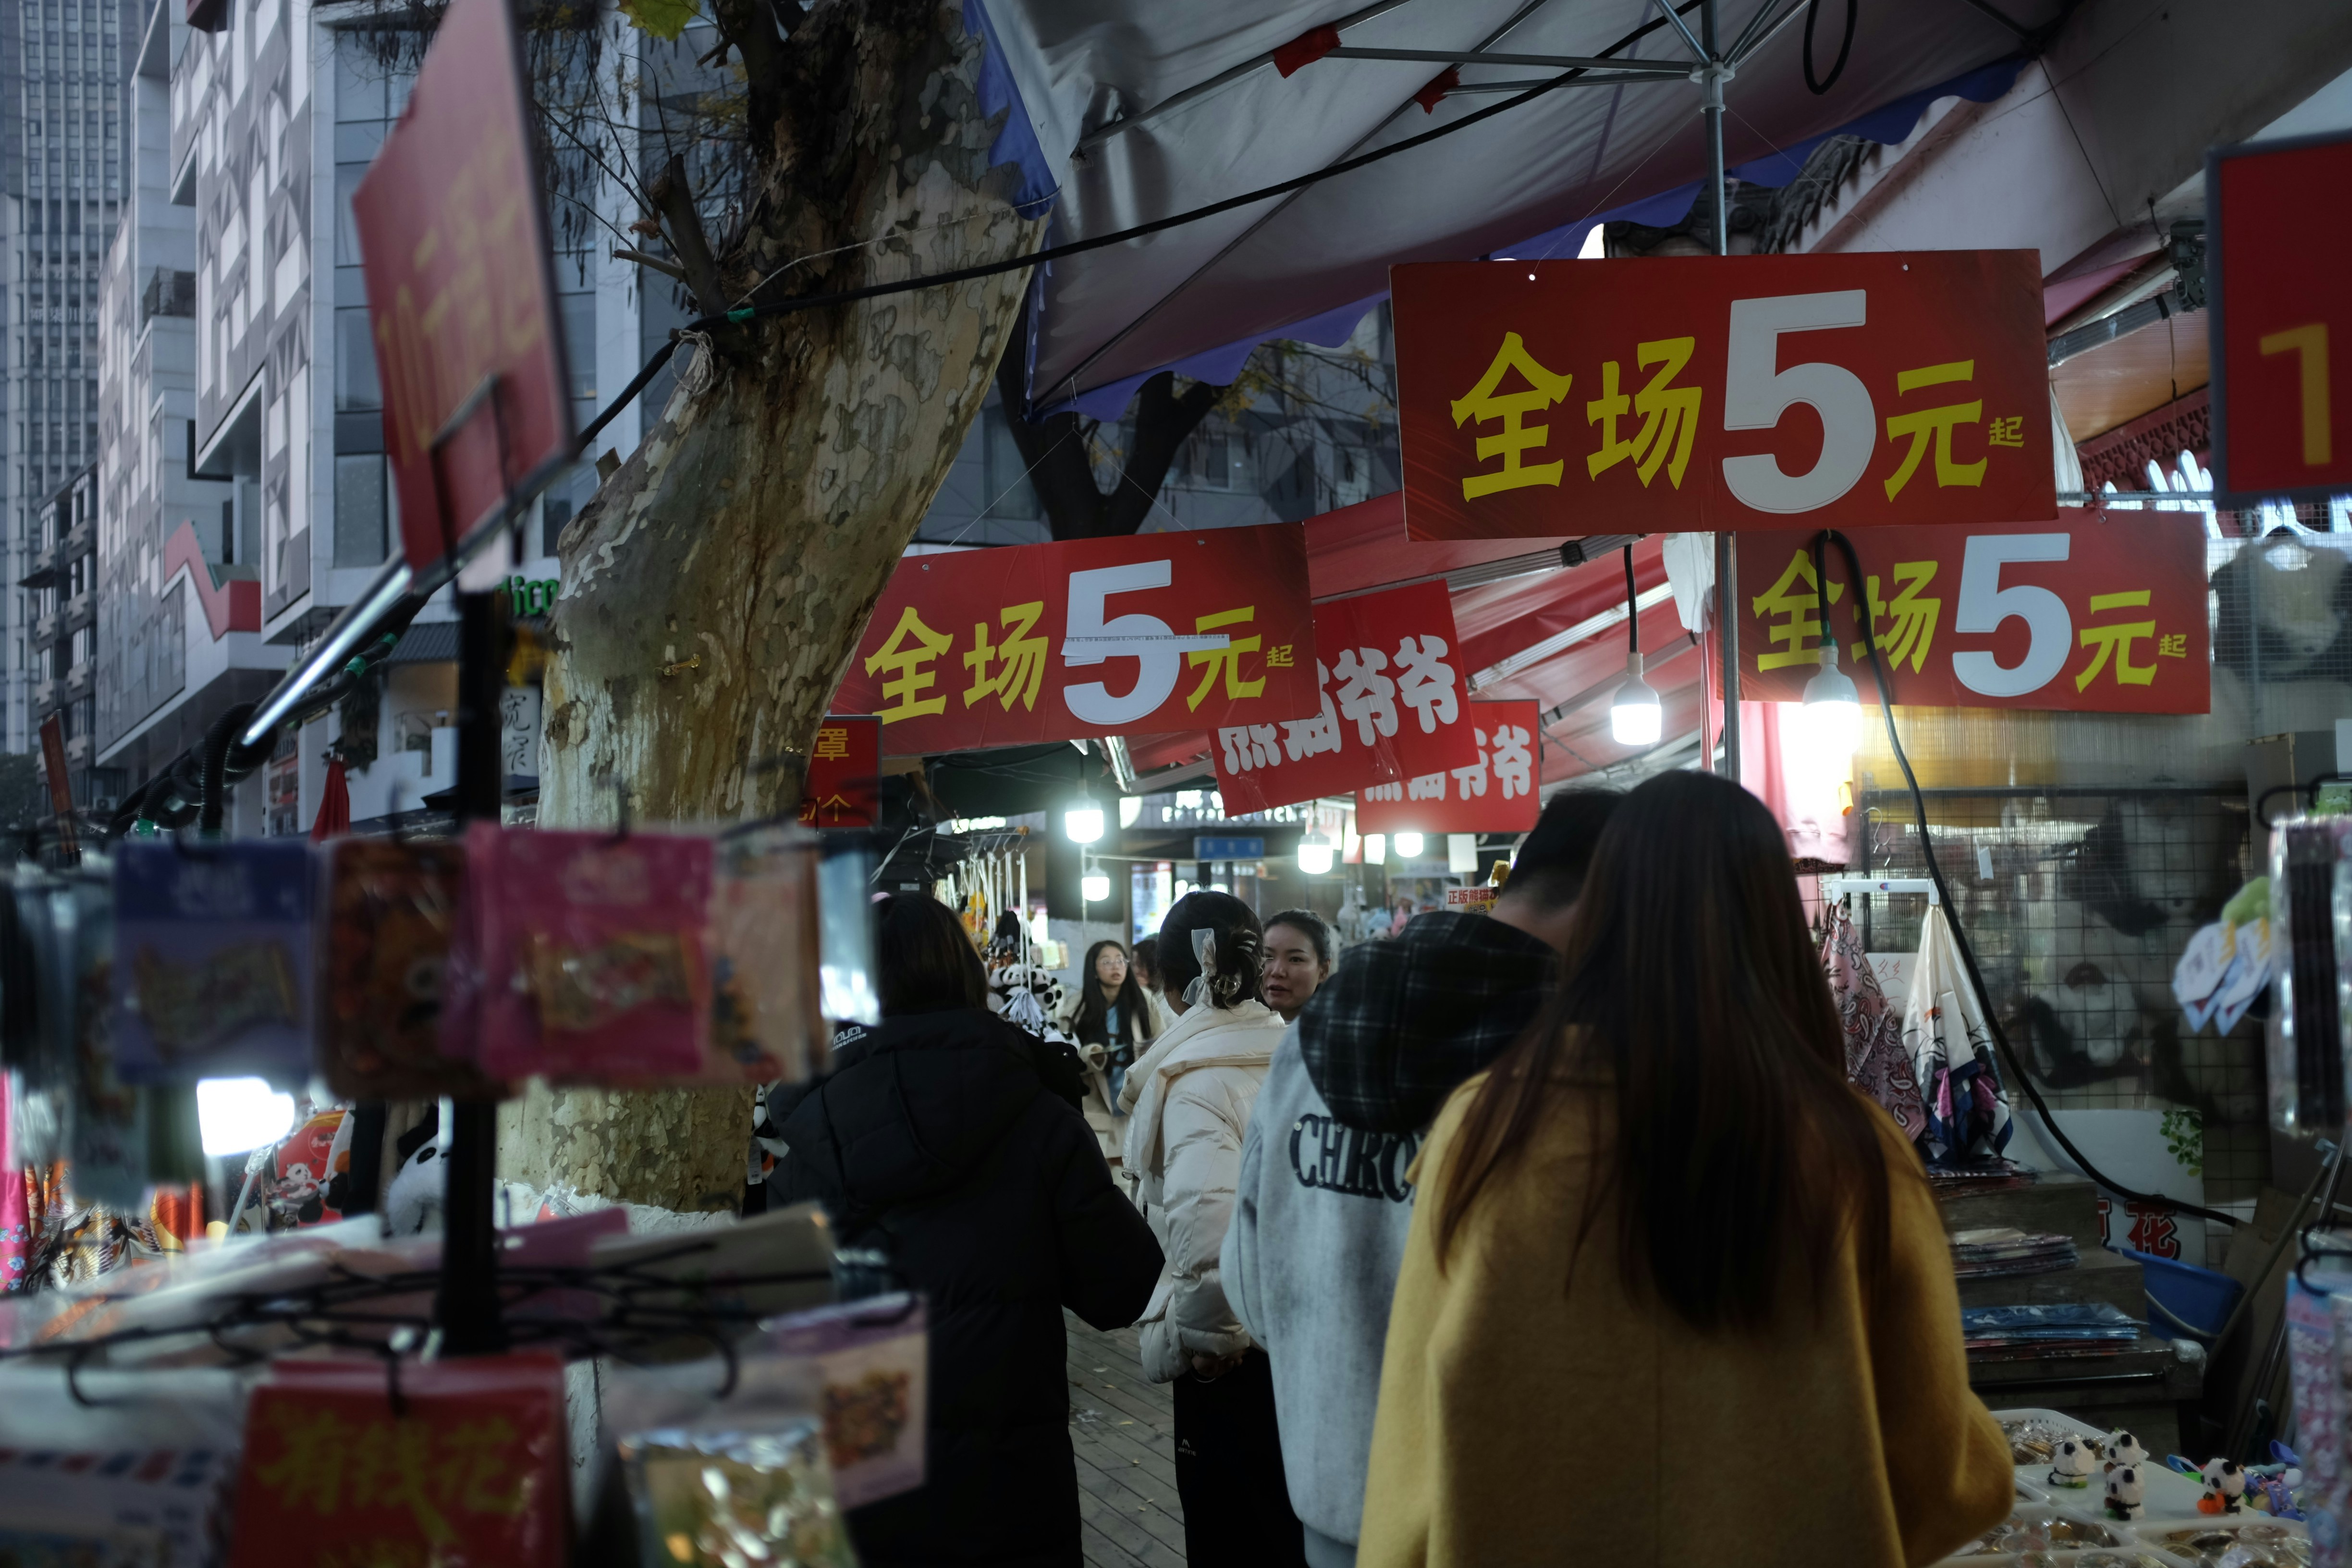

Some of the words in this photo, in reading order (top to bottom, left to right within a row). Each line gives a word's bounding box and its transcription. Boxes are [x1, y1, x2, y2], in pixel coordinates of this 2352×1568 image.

[1451, 289, 2024, 514] 全场5元起
[2260, 321, 2332, 466] 1
[864, 559, 1295, 725] 全场5元起
[1752, 532, 2187, 697] 全场5元起
[813, 728, 850, 761] 罩
[1364, 724, 1532, 802] 爷爷
[2098, 1195, 2181, 1261] 花
